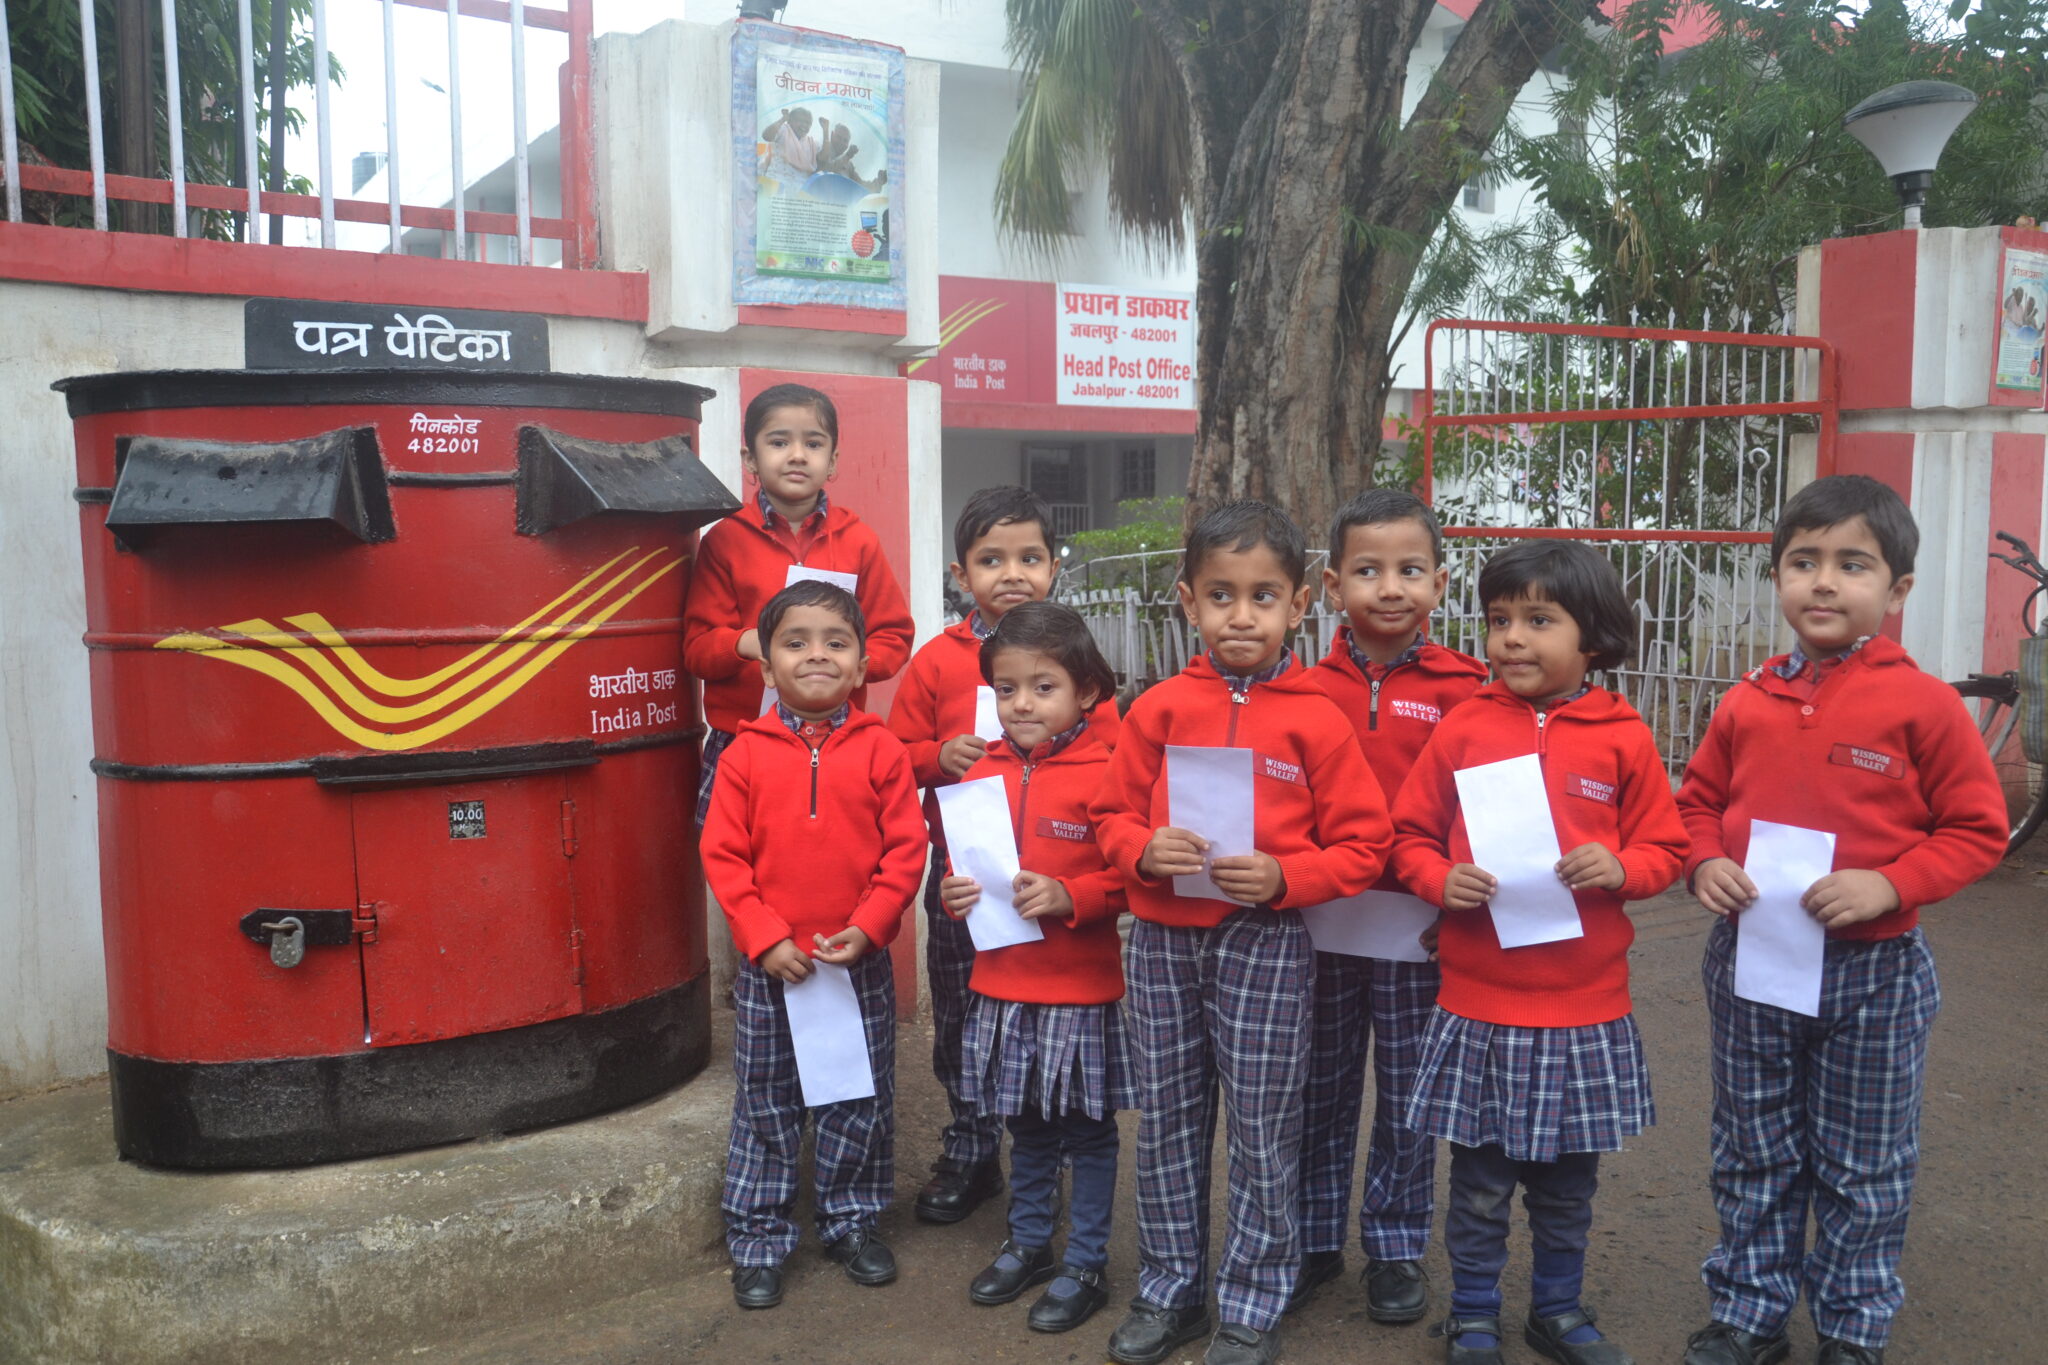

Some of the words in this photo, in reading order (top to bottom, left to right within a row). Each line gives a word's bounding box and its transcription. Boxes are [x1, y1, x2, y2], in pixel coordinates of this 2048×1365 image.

[775, 72, 821, 94] जीवन
[826, 82, 872, 100] प्रमाण
[1064, 292, 1120, 316] प्रधान
[1125, 296, 1190, 320] डाकघर
[293, 321, 373, 357] पत्र
[384, 313, 512, 362] पेटिका
[1070, 323, 1119, 344] जबलपुर
[1131, 328, 1177, 342] 482001
[953, 353, 985, 370] भारतीय
[988, 358, 1007, 371] डाक
[1064, 354, 1103, 376] Head
[1109, 355, 1141, 379] Post
[1147, 357, 1191, 380] Office
[955, 373, 978, 389] India
[986, 374, 1005, 389] Post
[1072, 382, 1126, 399] Jabalpur
[1137, 384, 1179, 399] 482001
[409, 412, 482, 435] पिनकोड
[408, 437, 479, 454] 482001
[589, 667, 650, 698] भारतीय
[652, 669, 676, 690] डाक
[592, 707, 641, 734] India
[647, 701, 677, 726] Post
[1852, 747, 1891, 765] WISDOM
[1852, 757, 1886, 772] VALLEY
[1266, 757, 1299, 774] WISDOM
[1267, 766, 1296, 782] VALLEY
[1580, 778, 1614, 794] WISDOM
[1582, 787, 1609, 801] VALLEY
[1052, 820, 1087, 832] WISDOM
[1054, 829, 1084, 840] VALLEY
